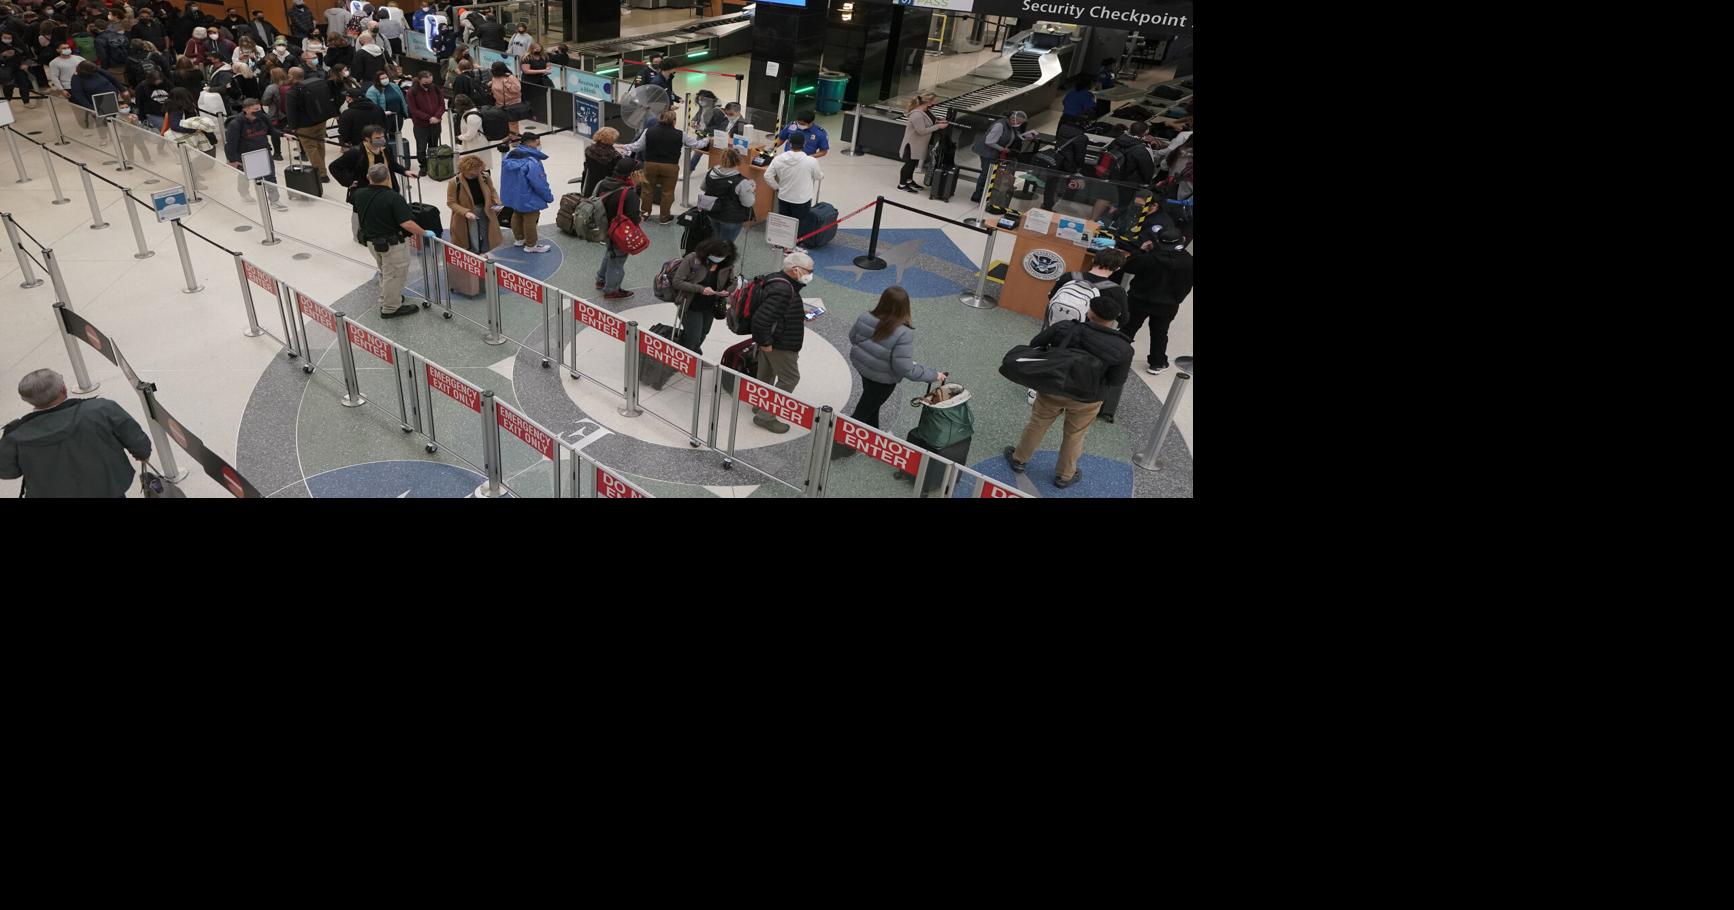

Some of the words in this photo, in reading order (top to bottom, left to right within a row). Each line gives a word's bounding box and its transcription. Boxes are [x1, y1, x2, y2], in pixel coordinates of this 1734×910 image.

[1022, 0, 1084, 19] Security
[1090, 6, 1187, 28] Checkpoint
[448, 247, 461, 259] DO
[463, 253, 482, 268] NOT
[451, 256, 481, 276] ENTER
[246, 262, 256, 274] DO
[258, 268, 273, 283] NOT
[248, 272, 273, 291] ENTER
[500, 269, 515, 282] DO
[518, 275, 539, 292] NOT
[503, 279, 538, 300] ENTER
[301, 296, 312, 309] DO
[315, 302, 332, 321] NOT
[304, 307, 332, 328] ENTER
[578, 303, 595, 316] DO
[598, 311, 623, 329] NOT
[351, 324, 364, 339] DO
[368, 332, 388, 350] NOT
[581, 313, 619, 338] ENTER
[354, 336, 388, 360] ENTER
[644, 334, 662, 349] DO
[666, 344, 693, 364] NOT
[647, 345, 688, 373] ENTER
[430, 366, 478, 399] EMERGENCY
[433, 378, 451, 394] EXIT
[453, 389, 475, 409] ONLY
[746, 381, 769, 398] DO
[774, 392, 808, 415] NOT
[748, 394, 803, 425] ENTER
[500, 406, 551, 445] EMERGENCY
[503, 419, 522, 438] EXIT
[525, 433, 548, 454] ONLY
[842, 421, 869, 440] DO
[875, 433, 916, 459] NOT
[844, 434, 907, 470] ENTER
[603, 472, 626, 494] DO
[991, 486, 1020, 498] D
